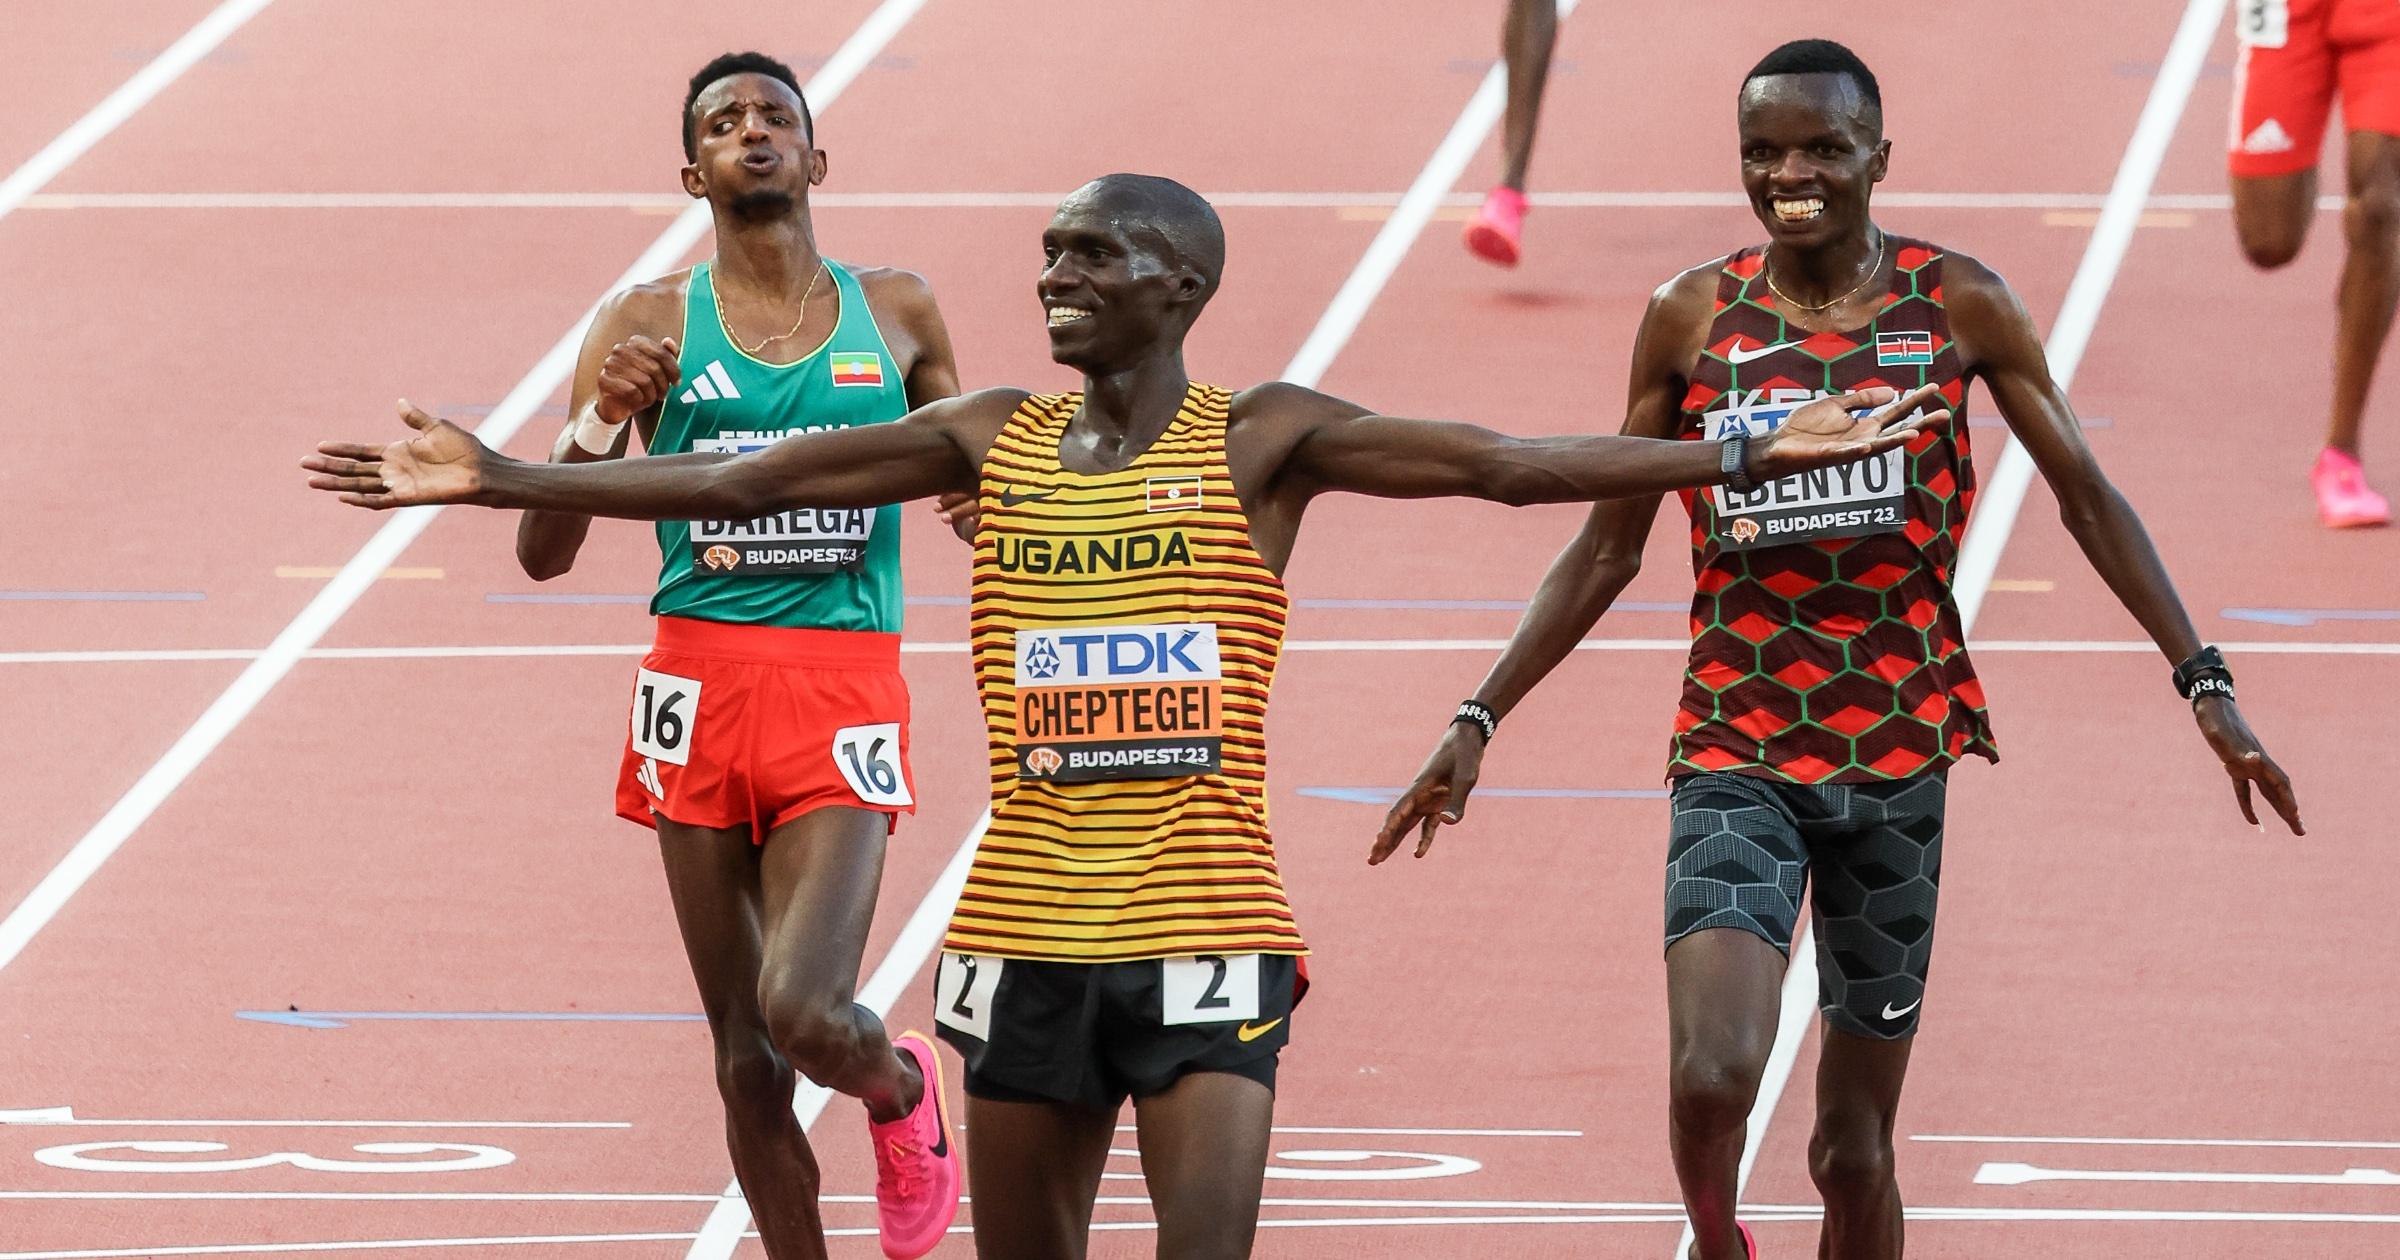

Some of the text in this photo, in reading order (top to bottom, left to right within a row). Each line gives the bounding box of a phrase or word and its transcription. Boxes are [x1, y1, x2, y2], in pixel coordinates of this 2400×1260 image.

[996, 532, 1191, 575] UGANDA
[1059, 631, 1203, 677] TDK
[642, 685, 686, 750] 16
[1024, 686, 1210, 738] CHEPTEGEI
[842, 737, 897, 795] 16
[951, 954, 978, 1021] 2
[1194, 955, 1230, 1010] 2
